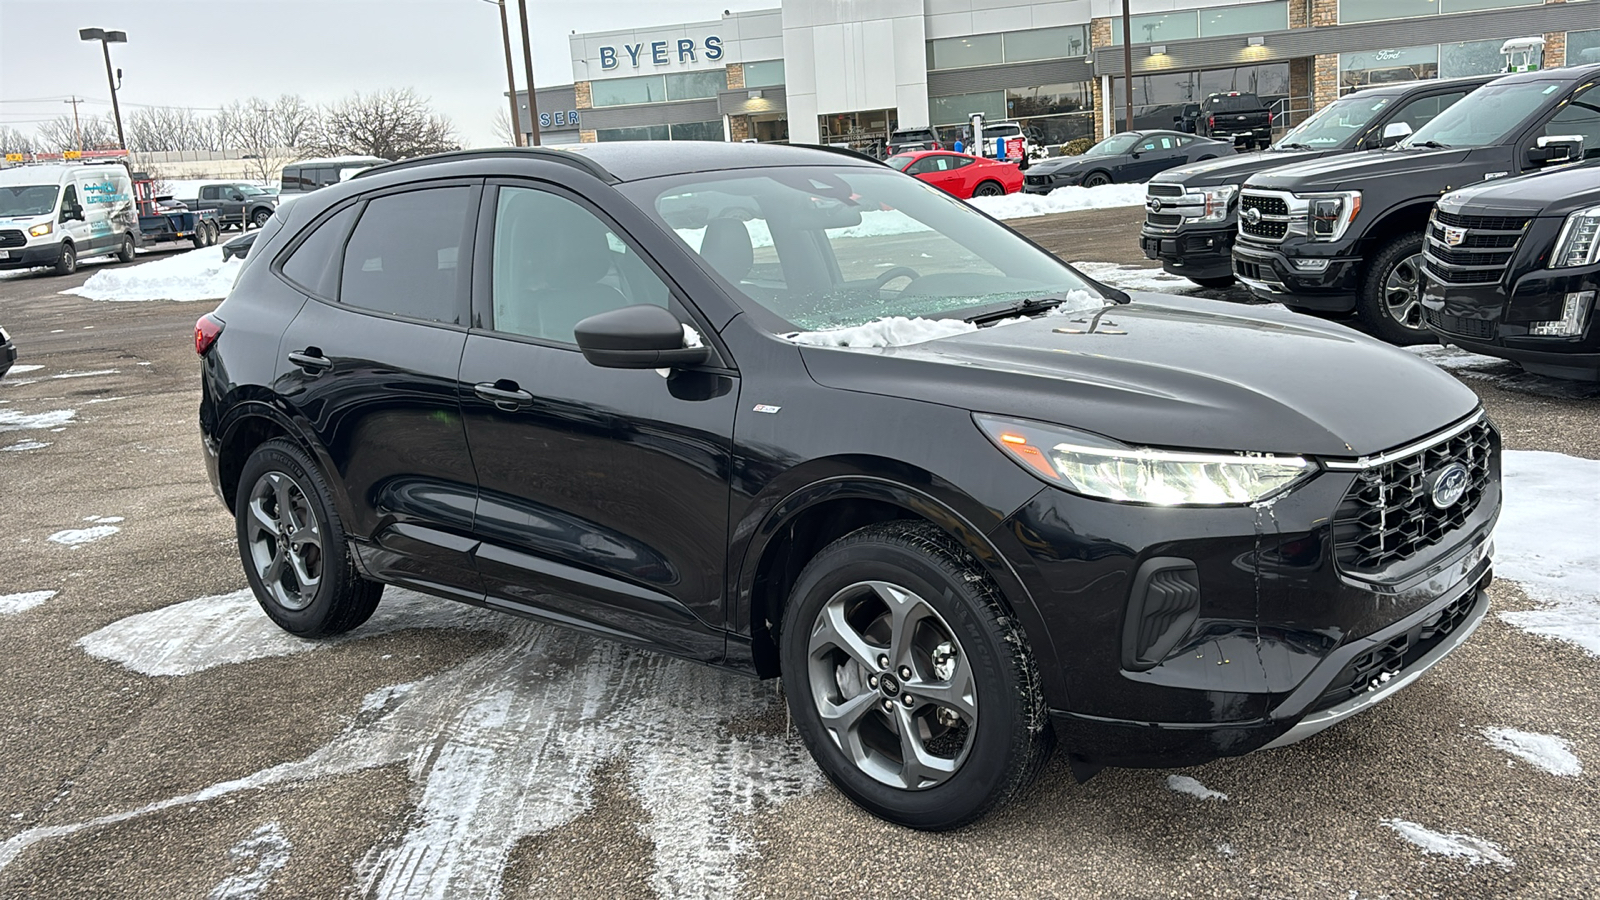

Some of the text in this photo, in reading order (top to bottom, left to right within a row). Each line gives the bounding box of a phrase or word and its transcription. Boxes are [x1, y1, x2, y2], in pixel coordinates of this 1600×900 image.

[599, 35, 724, 70] BYERS
[1375, 49, 1401, 61] Ford
[272, 453, 303, 478] MICHELIN
[1444, 471, 1465, 500] Ford
